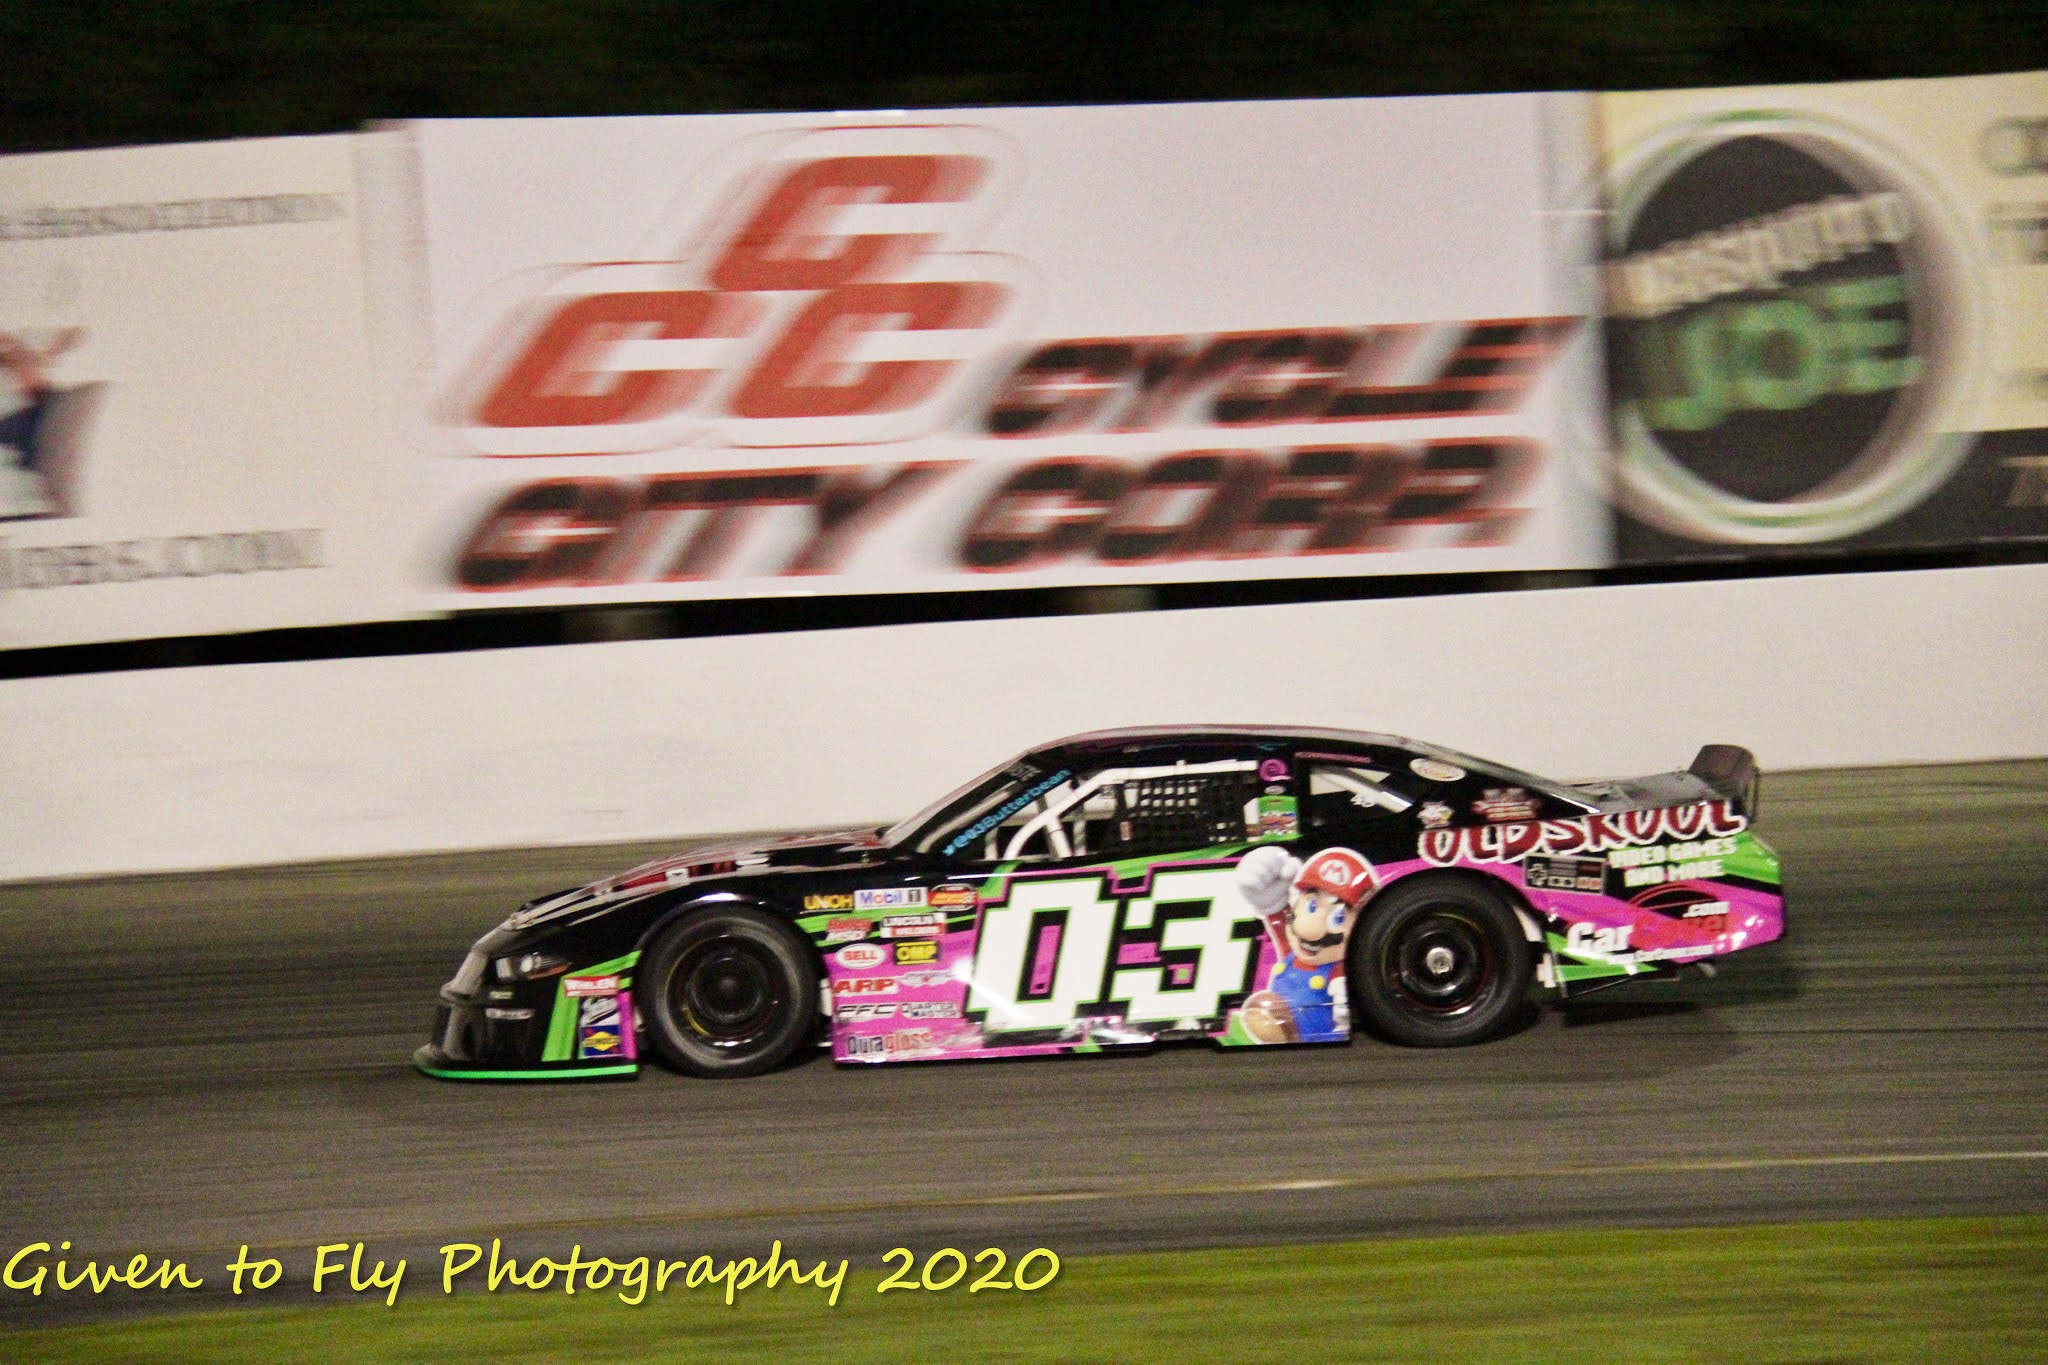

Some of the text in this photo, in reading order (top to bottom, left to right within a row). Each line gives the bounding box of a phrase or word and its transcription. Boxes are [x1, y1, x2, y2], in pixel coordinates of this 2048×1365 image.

[860, 891, 903, 905] Mobil
[843, 950, 878, 961] BELL
[966, 866, 1255, 1034] 03
[833, 979, 894, 993] ARP
